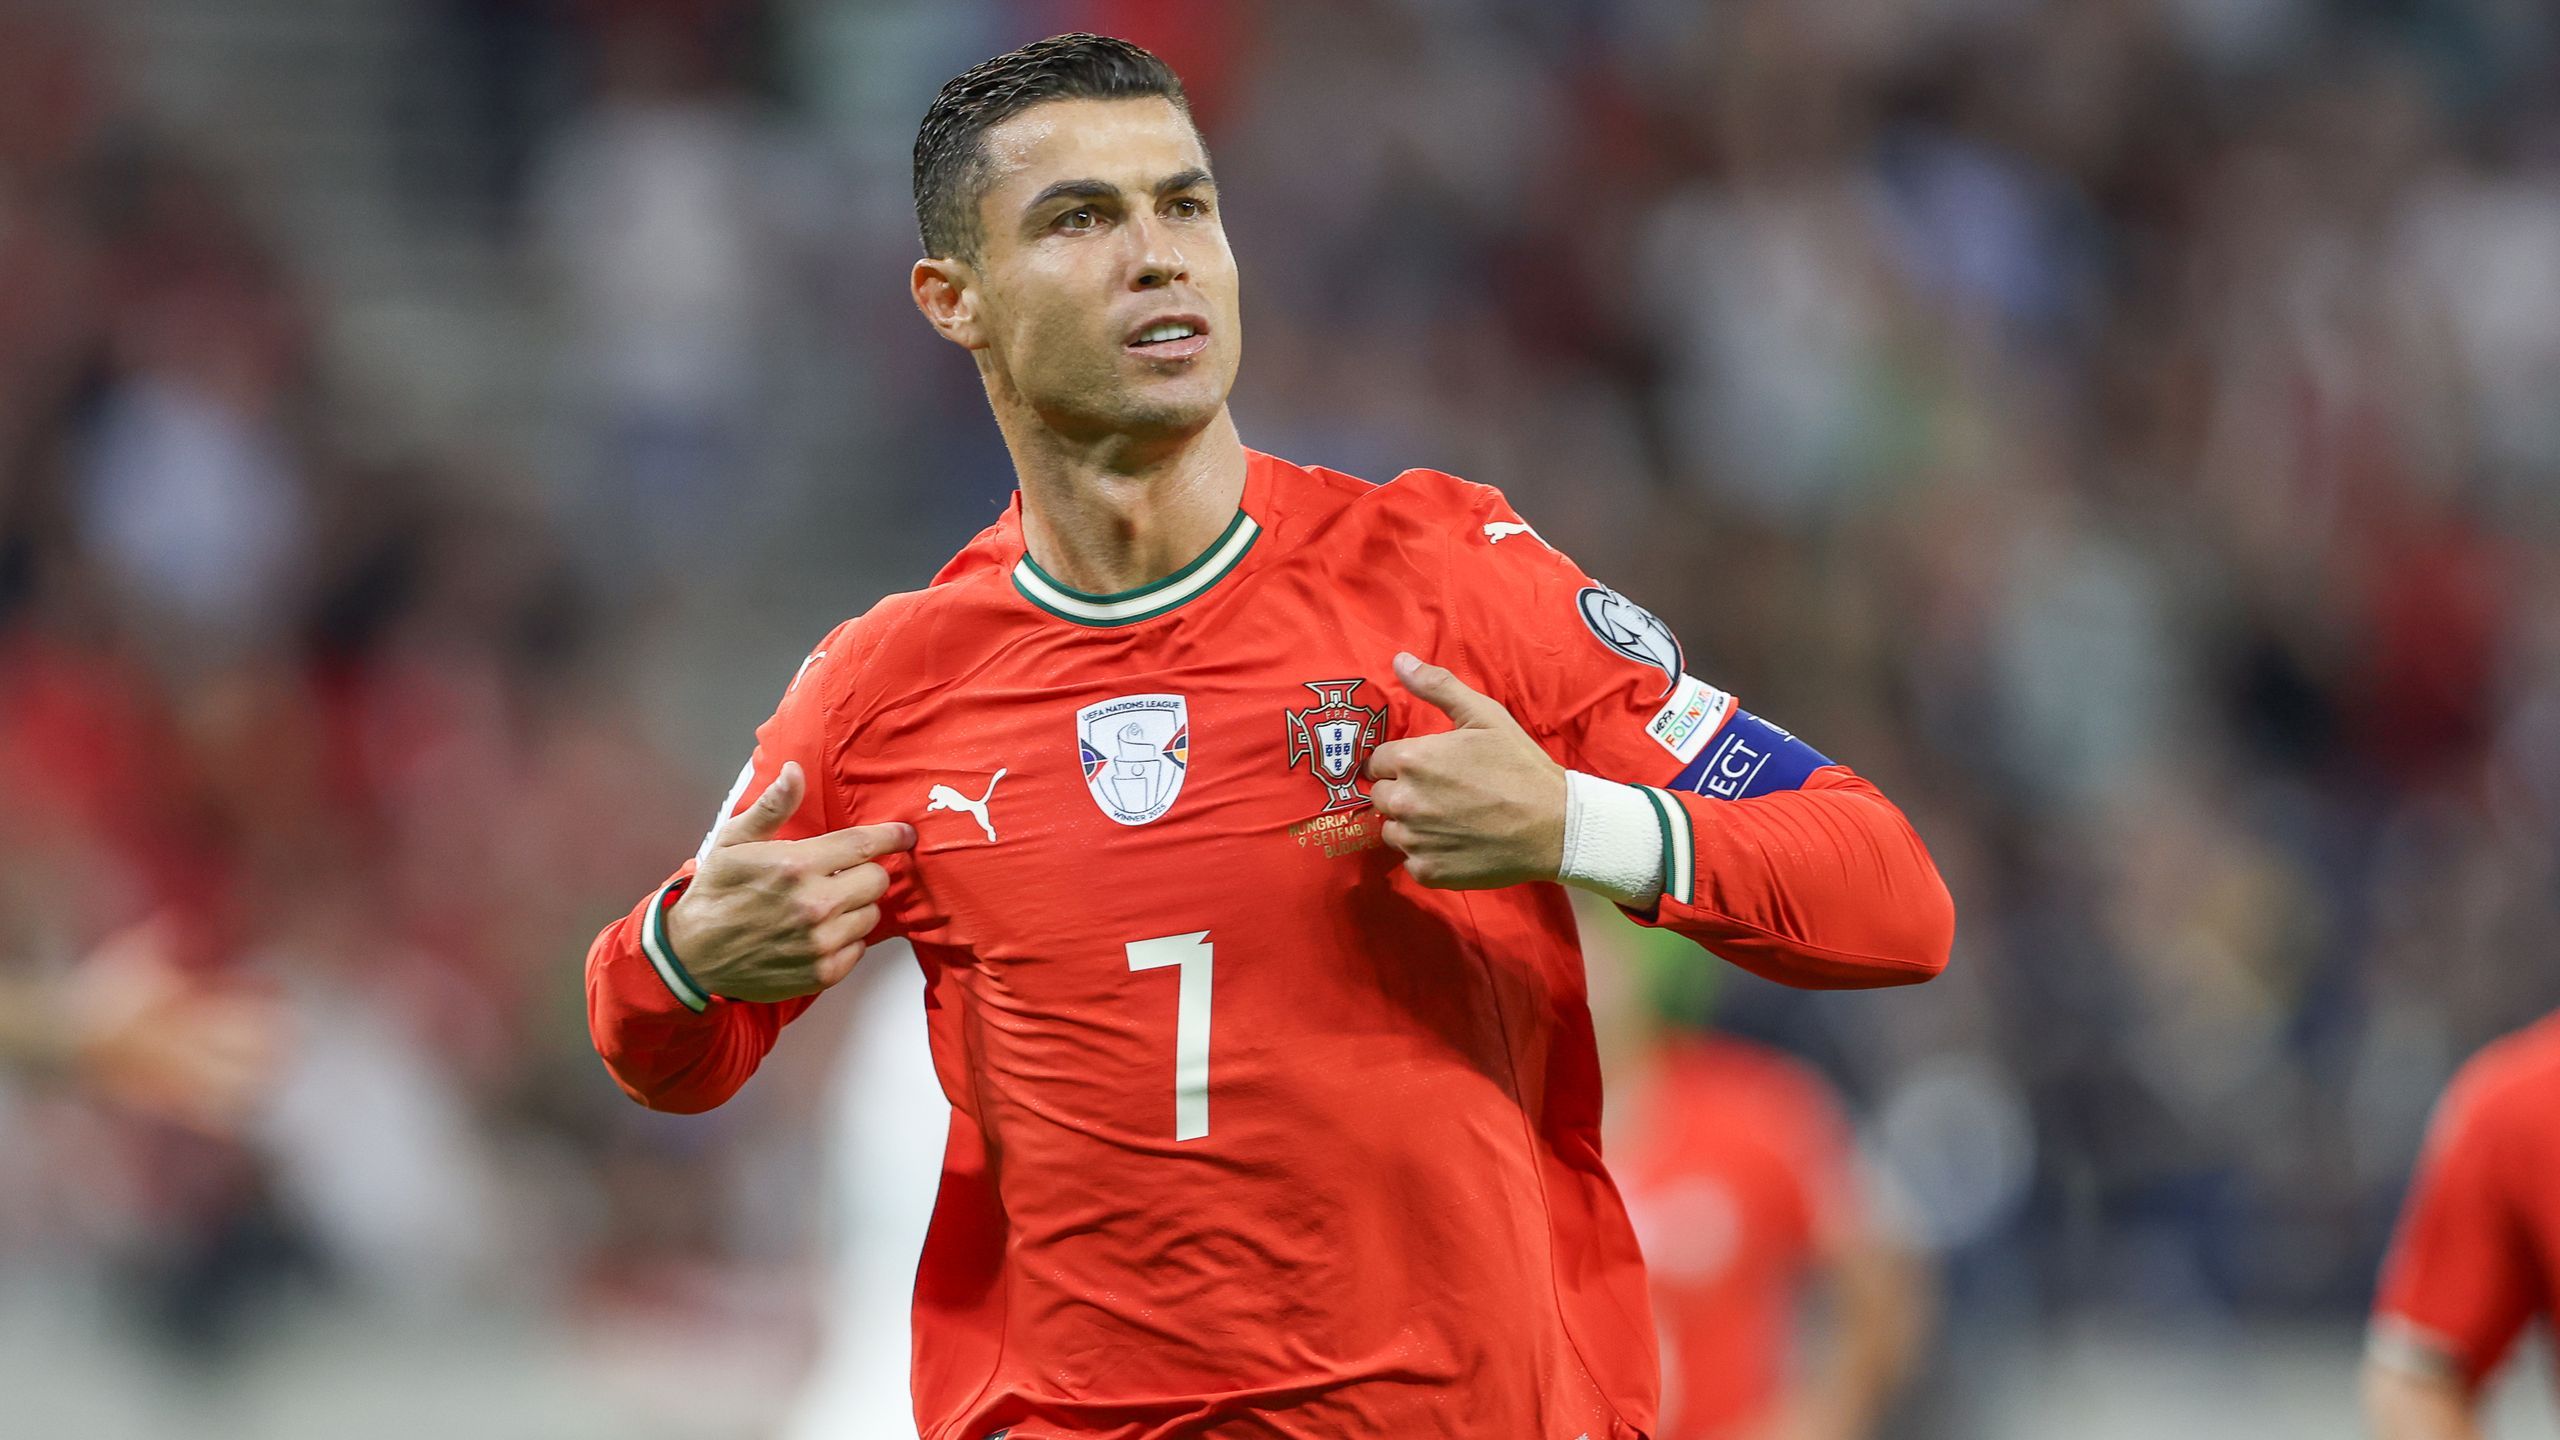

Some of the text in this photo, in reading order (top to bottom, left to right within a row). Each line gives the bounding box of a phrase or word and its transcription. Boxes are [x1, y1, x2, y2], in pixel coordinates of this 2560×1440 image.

[1082, 700, 1181, 721] UEFA NATIONS LEAGUE
[1652, 710, 1675, 734] UEFA
[1703, 739, 1759, 798] ECT
[1113, 810, 1146, 822] WINNER
[1297, 836, 1307, 848] 9
[1125, 930, 1213, 1142] 7
